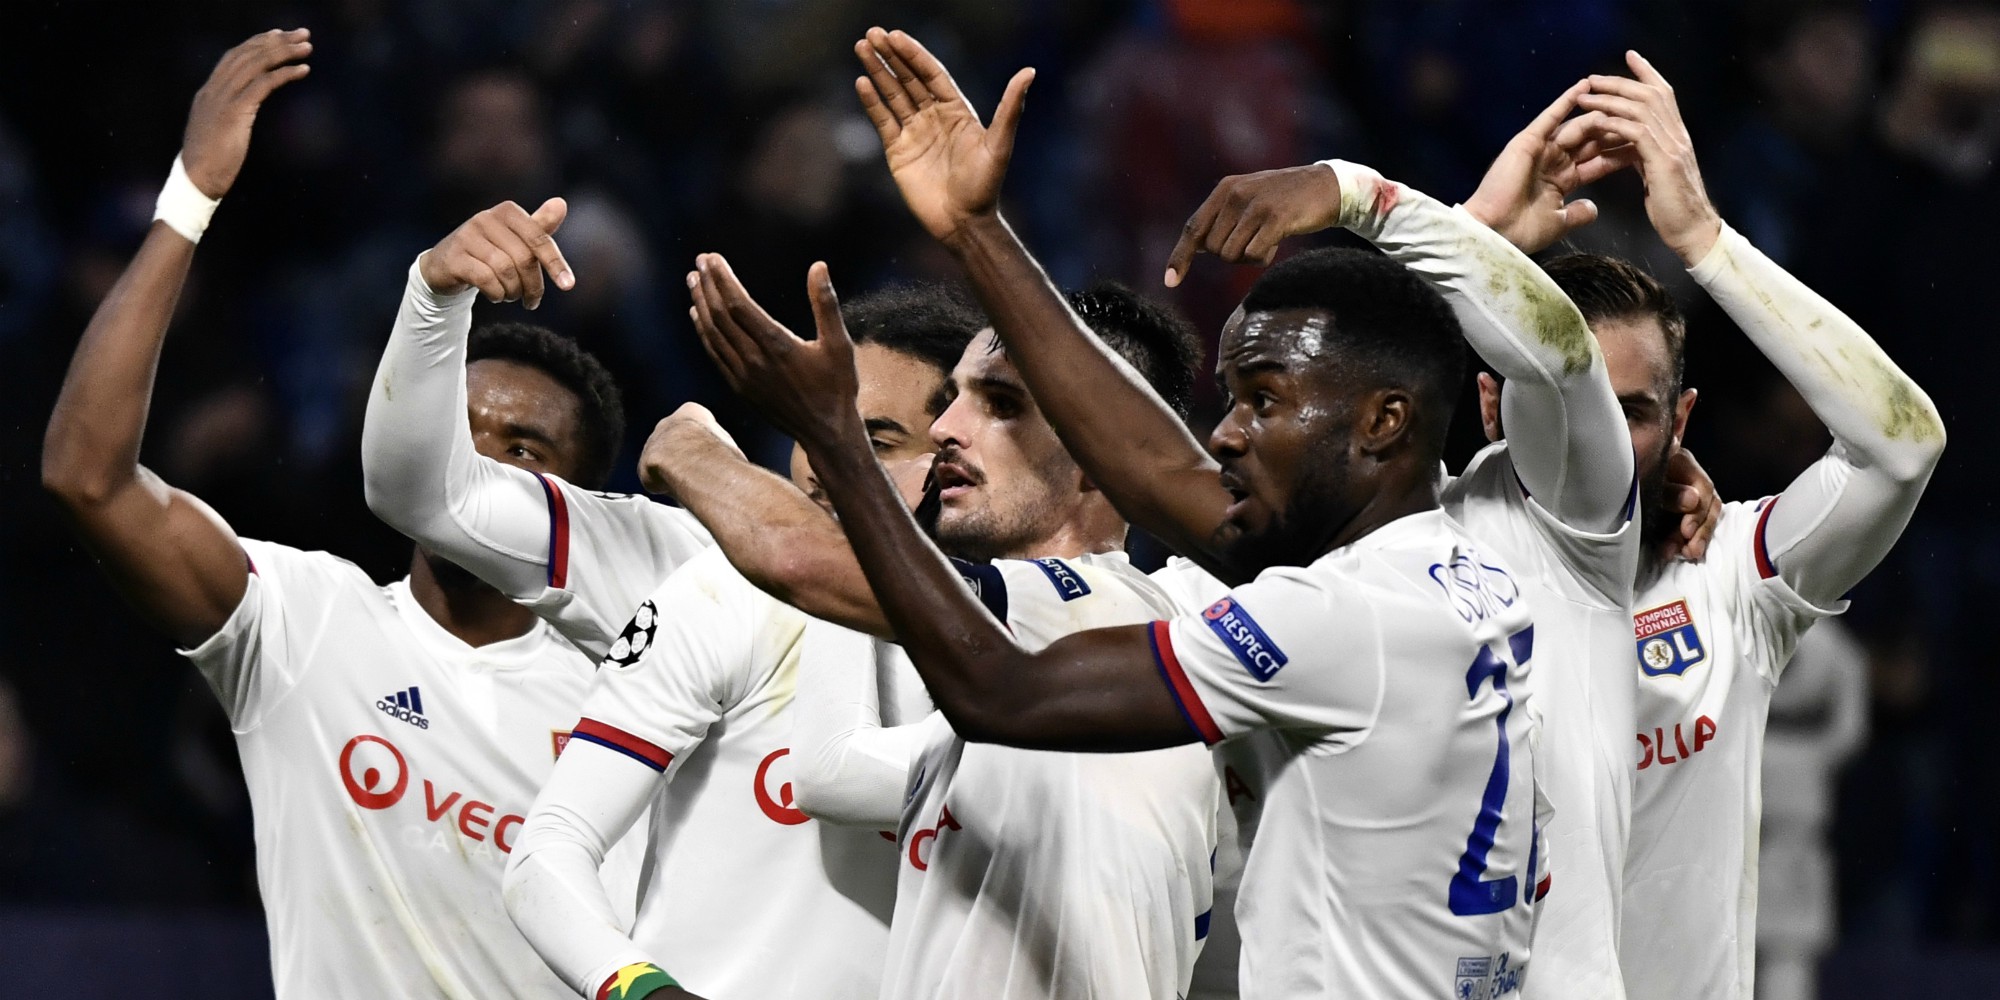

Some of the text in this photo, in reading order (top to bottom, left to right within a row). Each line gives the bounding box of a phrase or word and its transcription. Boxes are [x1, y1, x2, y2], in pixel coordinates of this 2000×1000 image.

[1634, 604, 1684, 628] LYMPIQUE
[1219, 612, 1280, 674] RESPECT
[376, 700, 430, 730] adidas
